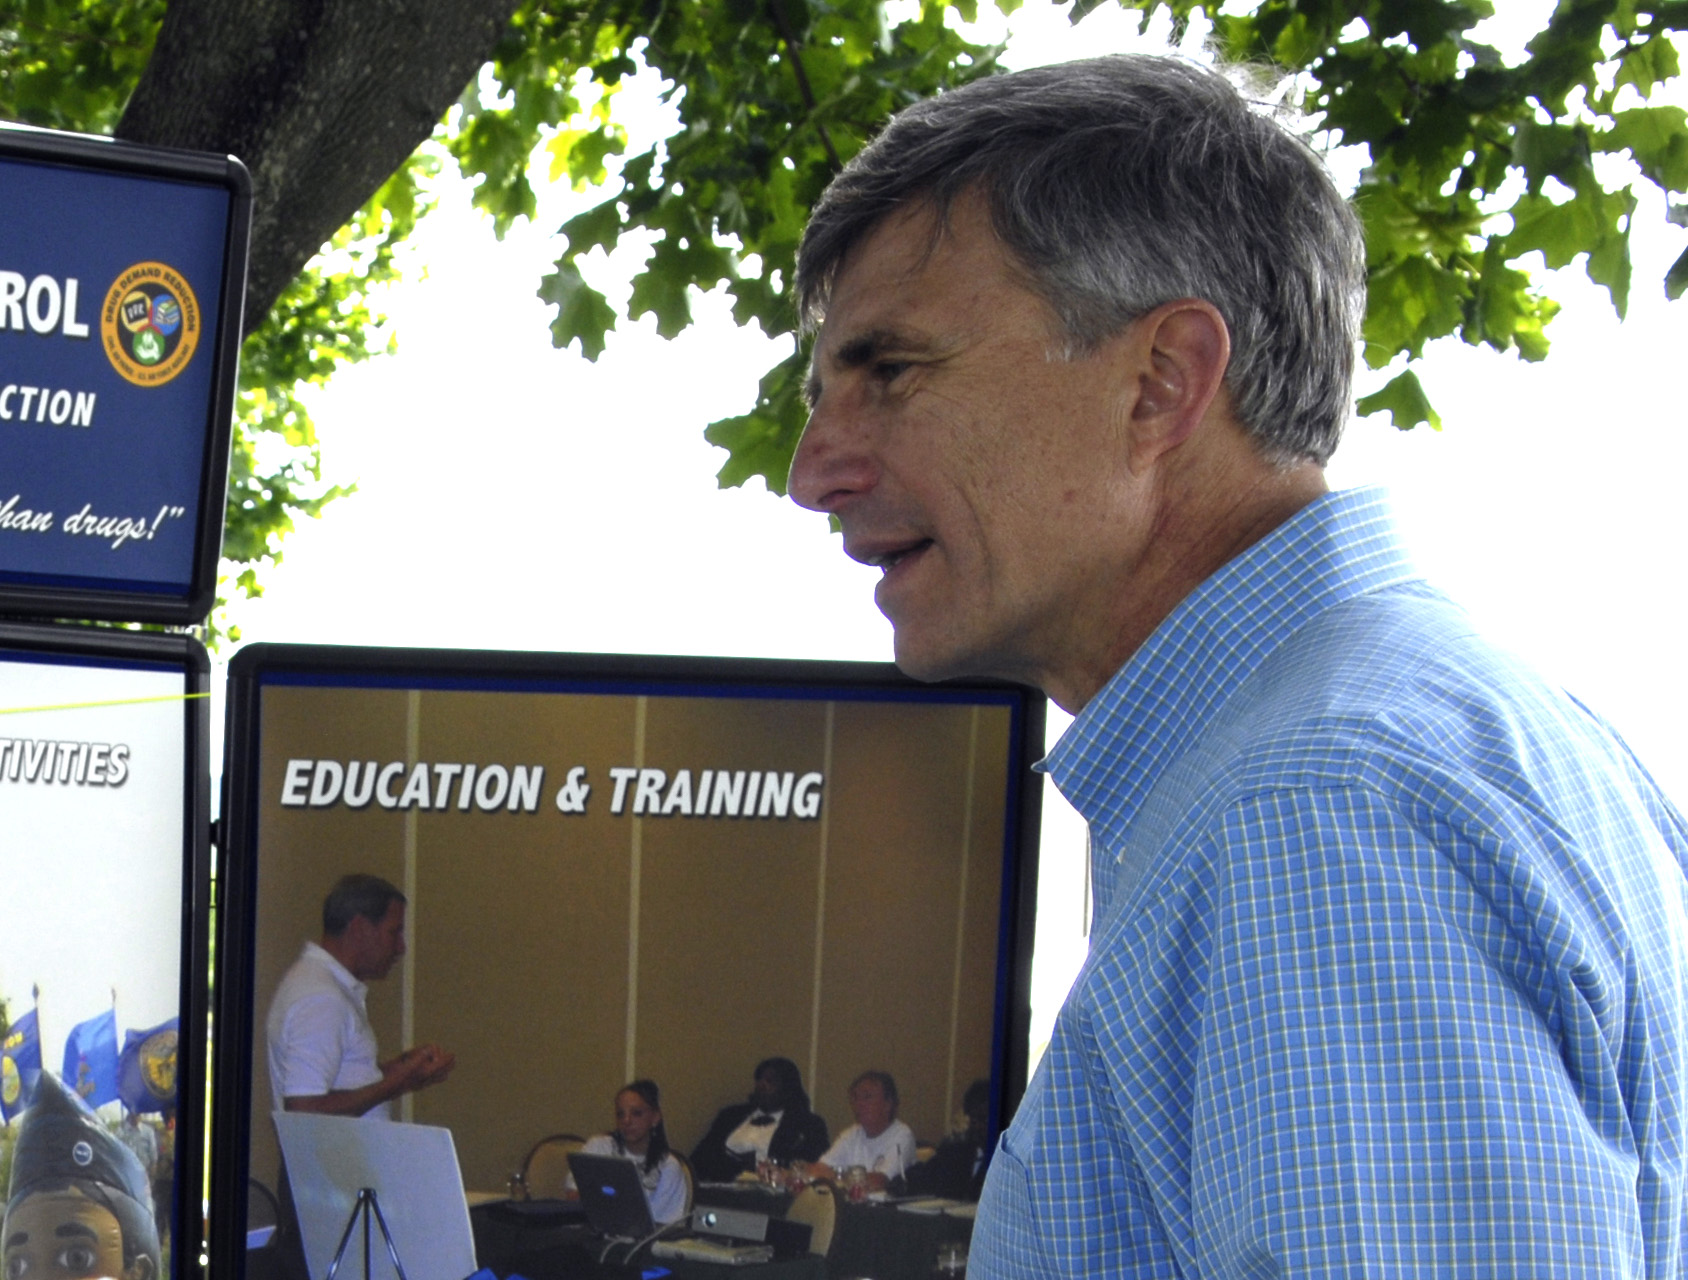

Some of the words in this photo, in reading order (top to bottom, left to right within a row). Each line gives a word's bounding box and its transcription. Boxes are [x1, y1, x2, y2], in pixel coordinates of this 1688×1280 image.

[281, 759, 544, 811] EDUCATION
[555, 766, 589, 813] &
[609, 768, 823, 818] TRAINING
